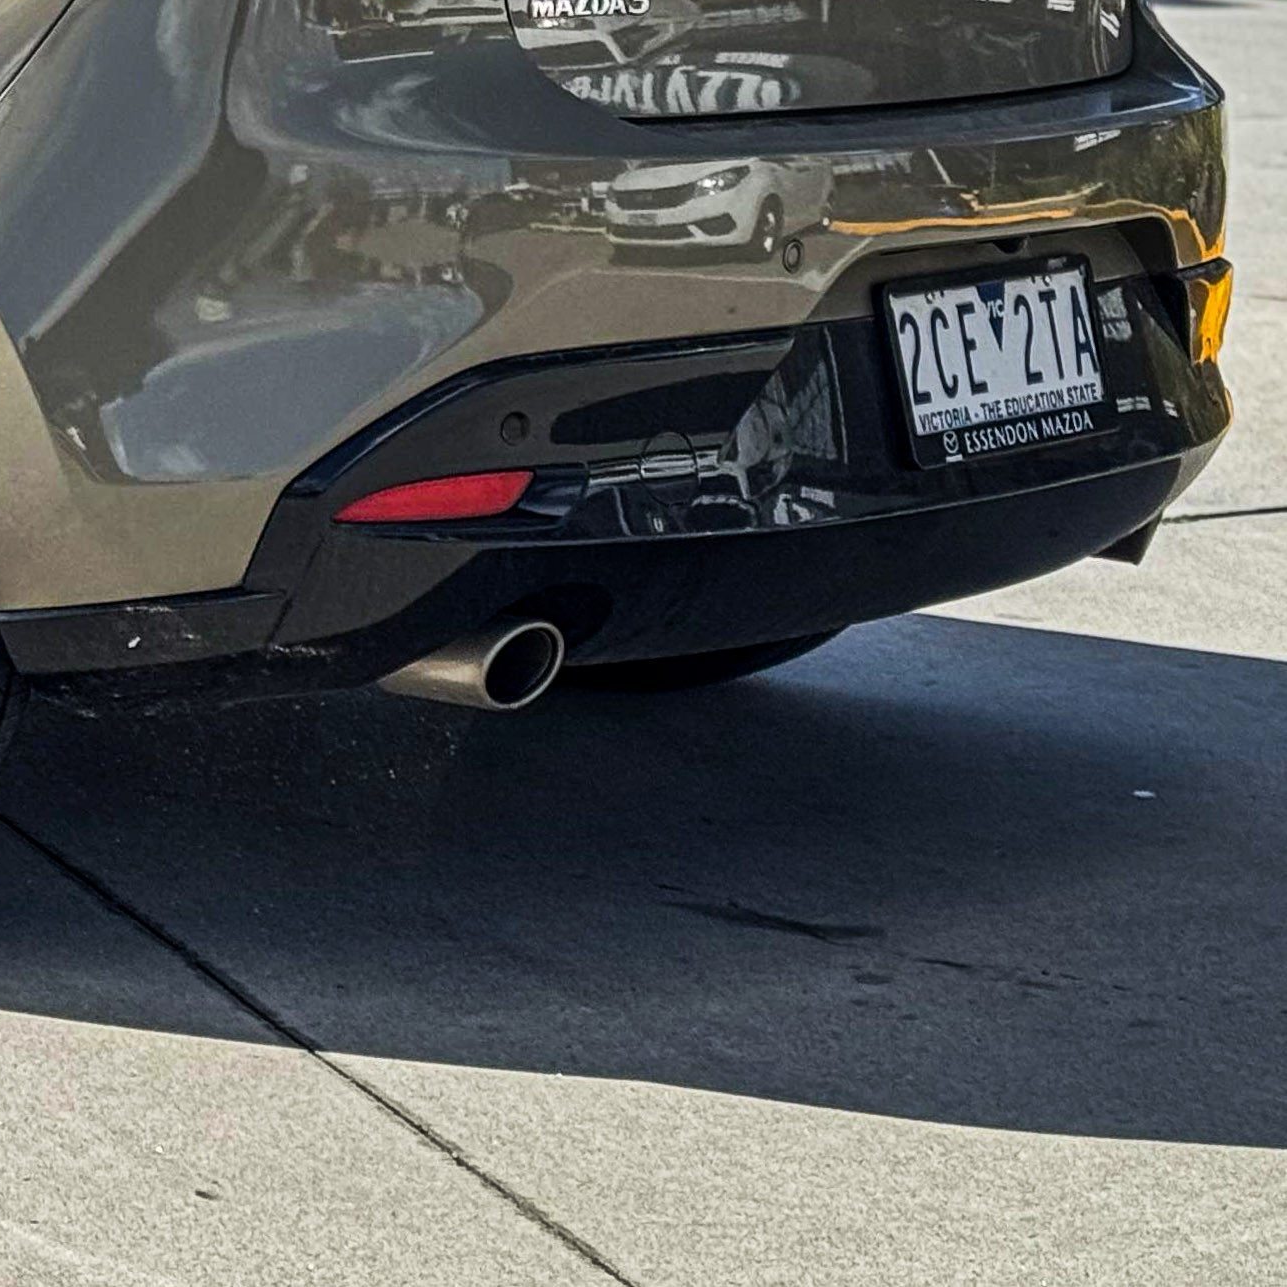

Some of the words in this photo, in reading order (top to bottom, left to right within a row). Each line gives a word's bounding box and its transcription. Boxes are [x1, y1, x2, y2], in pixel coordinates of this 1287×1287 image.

[898, 300, 989, 406] 2CE
[1013, 284, 1101, 386] 2TA
[917, 405, 973, 433] VICTORIA
[980, 399, 1003, 419] THE
[1004, 389, 1066, 417] EDUCATION
[1067, 382, 1099, 405] STATE
[963, 420, 1040, 454] ESSENDON
[1042, 409, 1095, 442] MAZDA
